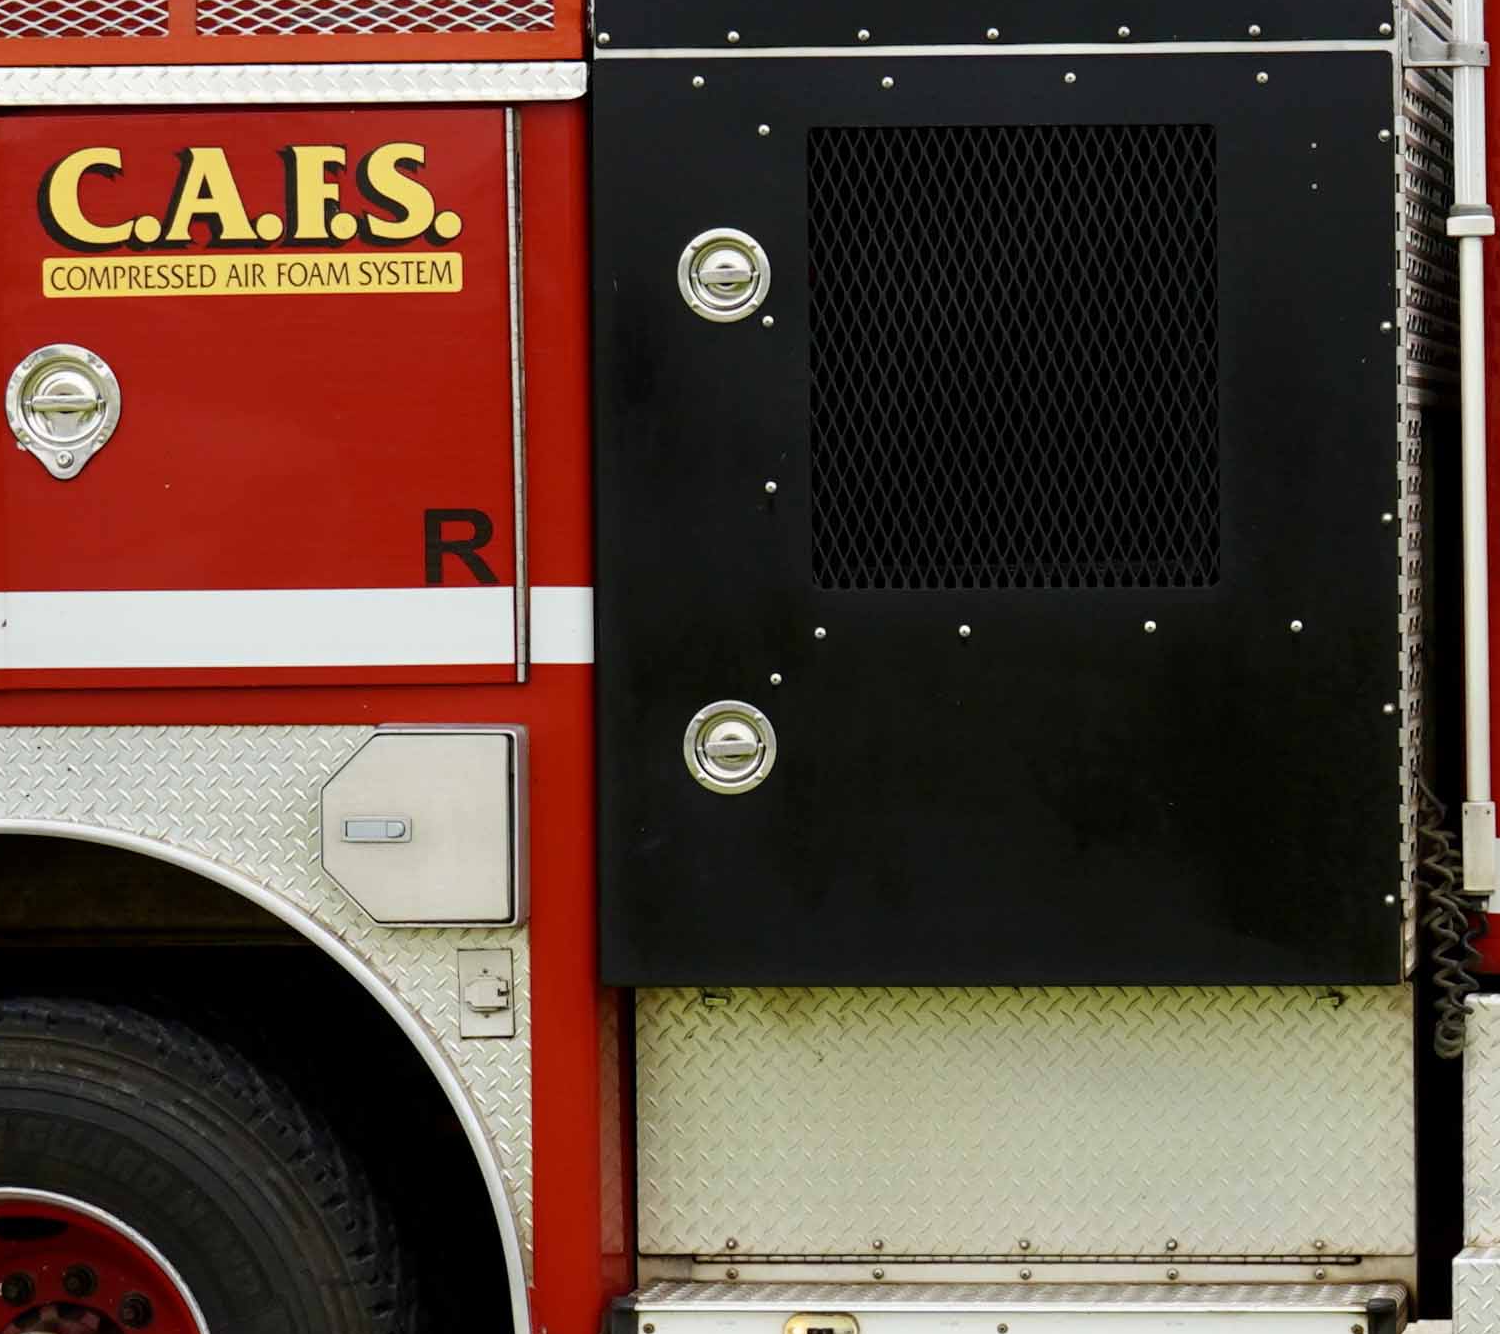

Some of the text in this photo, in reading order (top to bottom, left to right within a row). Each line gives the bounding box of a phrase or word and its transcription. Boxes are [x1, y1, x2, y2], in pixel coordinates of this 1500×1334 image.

[38, 142, 462, 251] C.A.F.S.
[49, 260, 453, 291] COMPRESSED AIR FOAM SYSTEM
[423, 508, 500, 584] R
